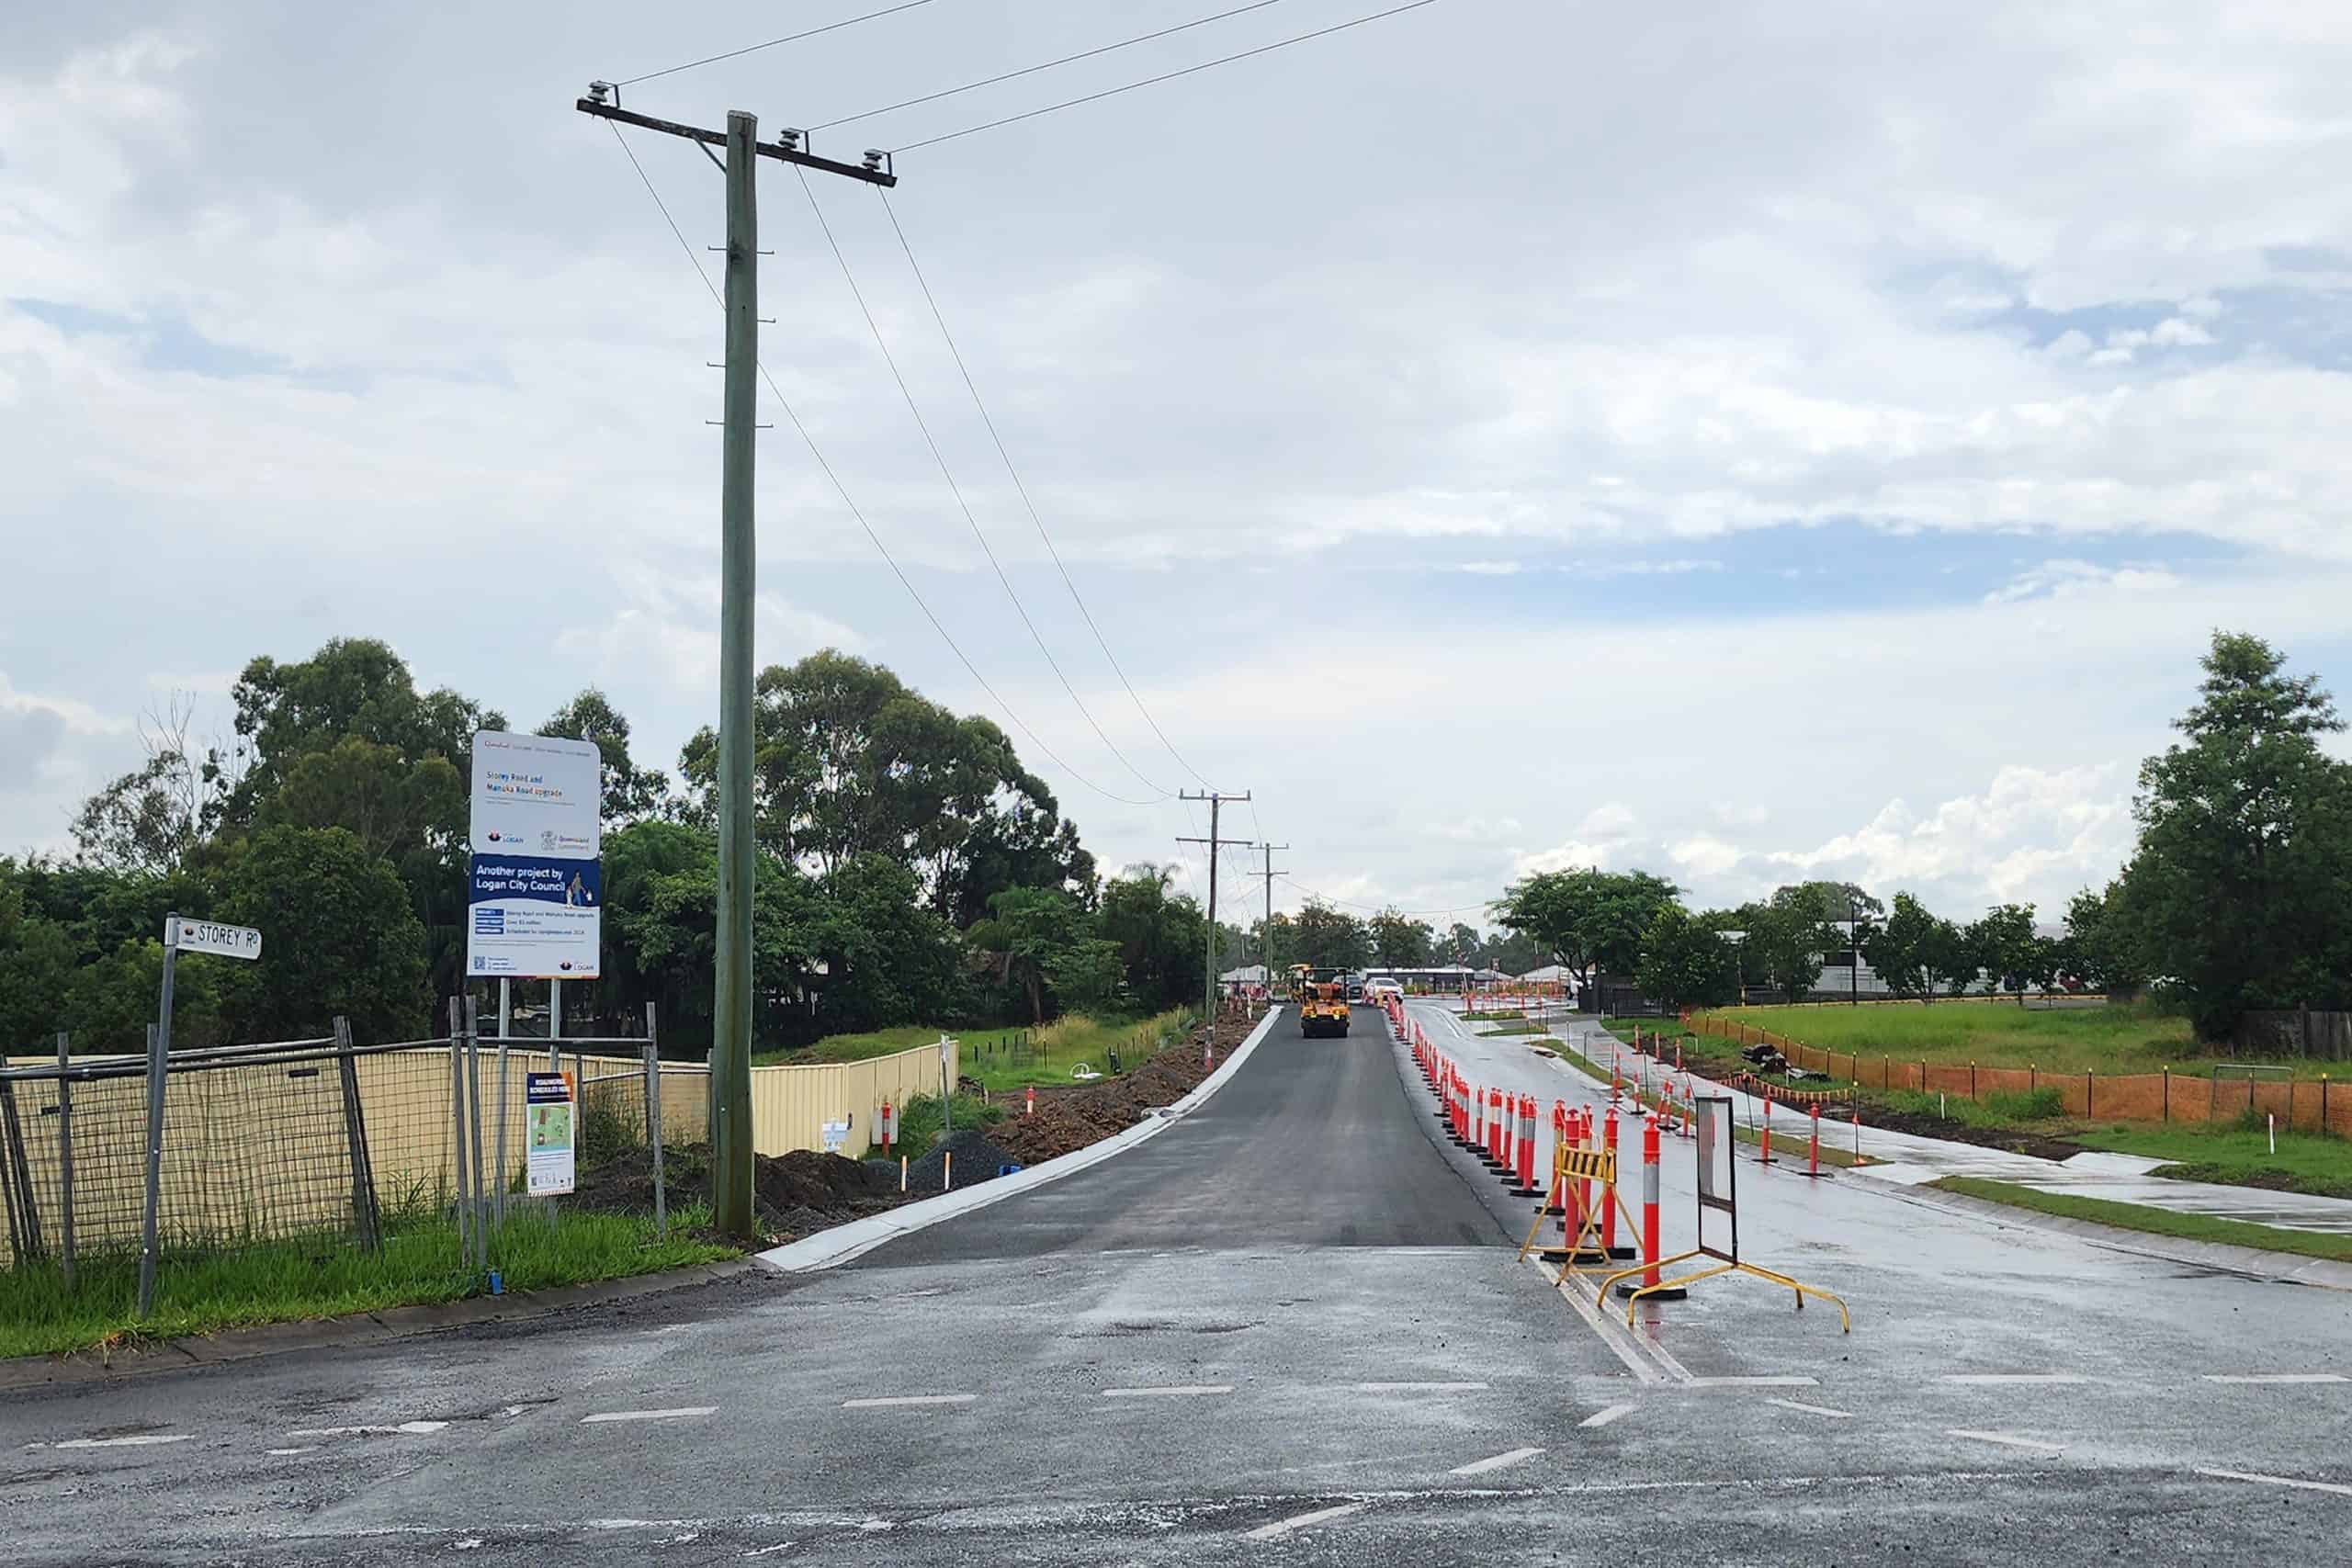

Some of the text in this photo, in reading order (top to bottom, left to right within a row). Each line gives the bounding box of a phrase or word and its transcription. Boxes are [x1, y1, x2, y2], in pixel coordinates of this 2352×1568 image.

[485, 772, 543, 784] Storey Road and
[515, 785, 533, 795] Road
[476, 865, 563, 881] Another project by
[476, 878, 565, 892] Logan City Council
[198, 925, 258, 948] STOREY RD
